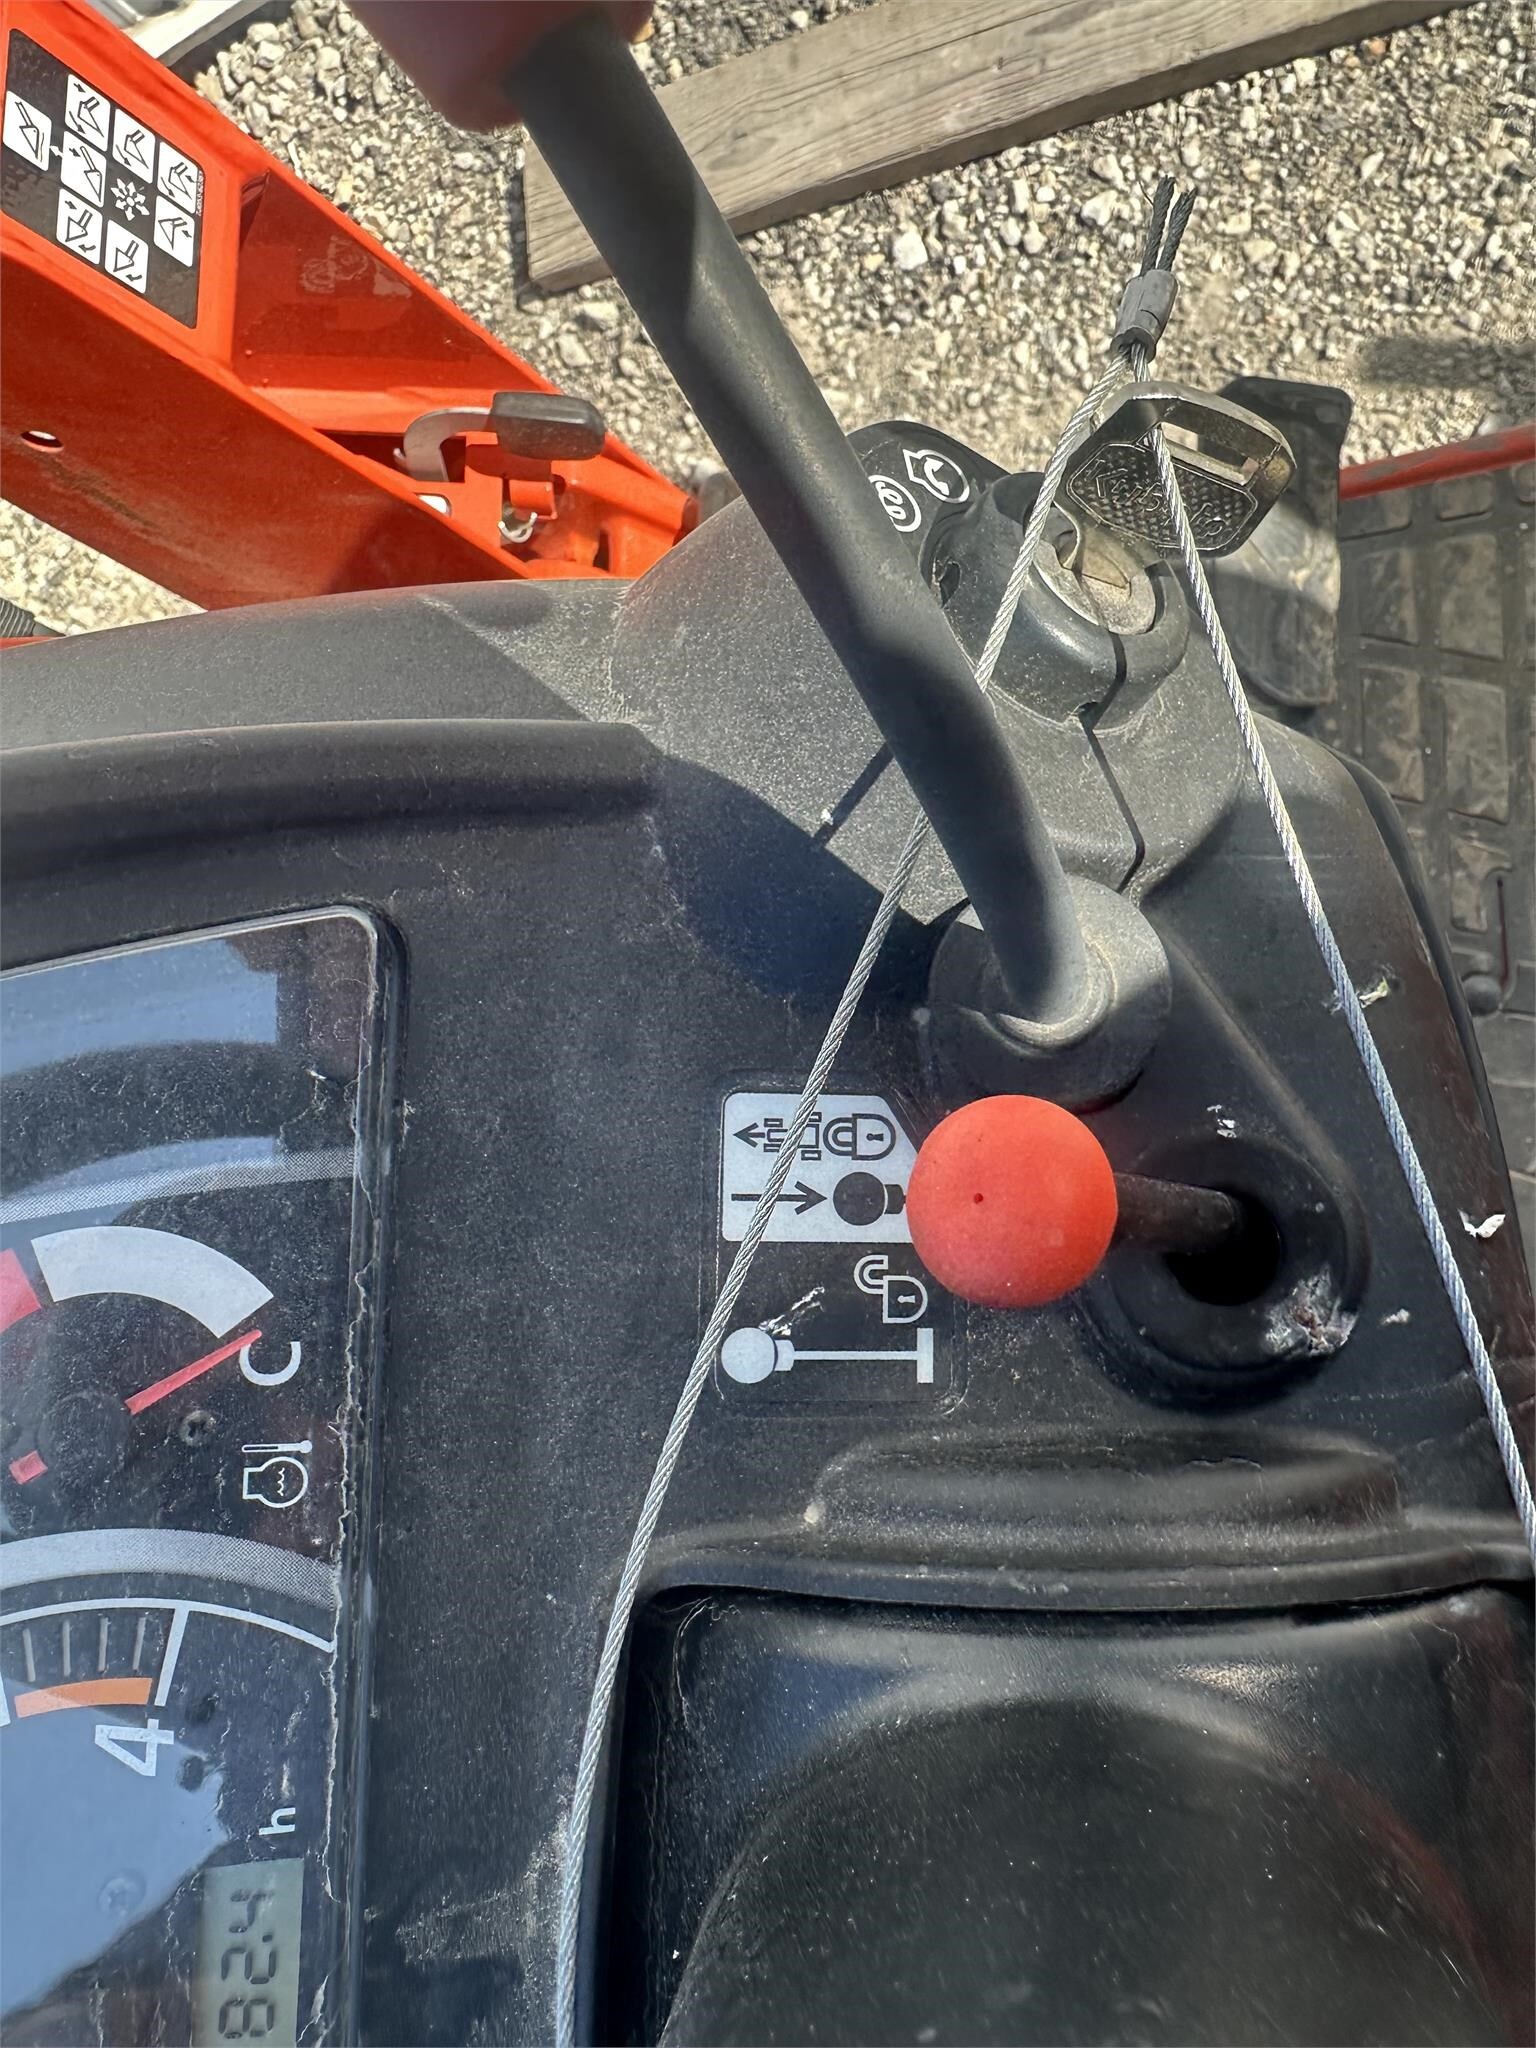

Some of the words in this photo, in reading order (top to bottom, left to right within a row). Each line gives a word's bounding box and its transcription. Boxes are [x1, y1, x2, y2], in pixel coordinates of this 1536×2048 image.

[239, 1341, 301, 1386] C
[95, 1719, 174, 1777] 4
[218, 1888, 277, 2040] 82.4
[258, 1807, 296, 1836] h
